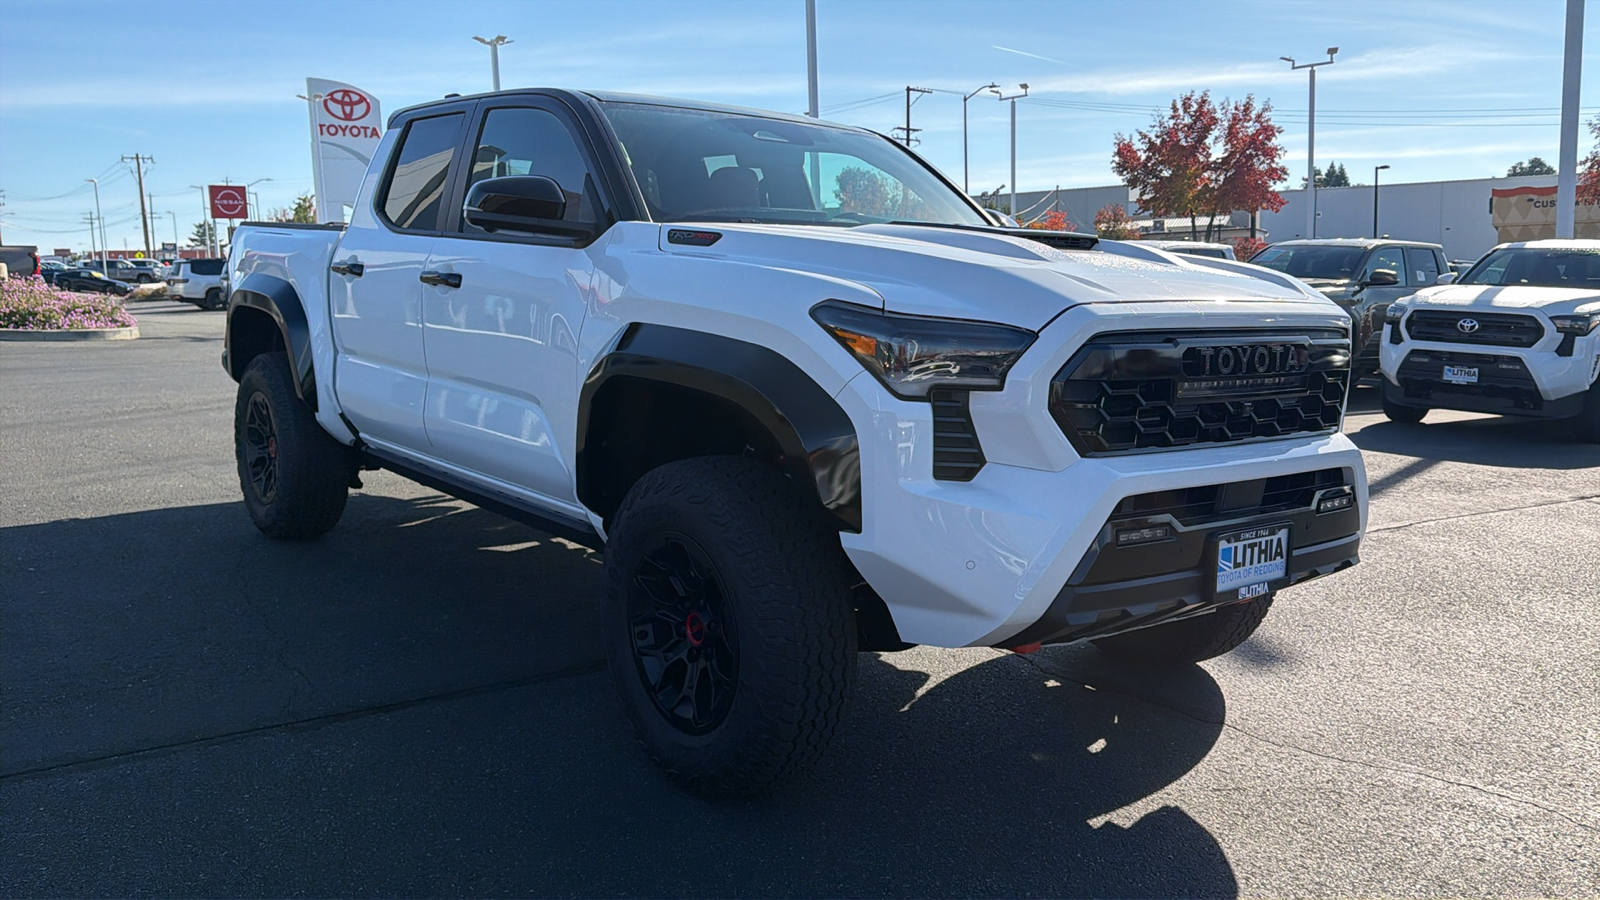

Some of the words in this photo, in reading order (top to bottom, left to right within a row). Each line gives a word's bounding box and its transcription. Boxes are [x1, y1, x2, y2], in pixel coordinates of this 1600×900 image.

[319, 124, 381, 139] TOYOTA
[671, 231, 694, 239] TRD
[1199, 346, 1299, 374] TOYOTA
[1452, 368, 1476, 377] LITHIA
[1240, 531, 1256, 540] SINCE
[1233, 537, 1284, 569] LITHIA
[1217, 570, 1242, 584] TOYOTA
[1243, 567, 1253, 578] OF
[1254, 561, 1284, 576] REDDING
